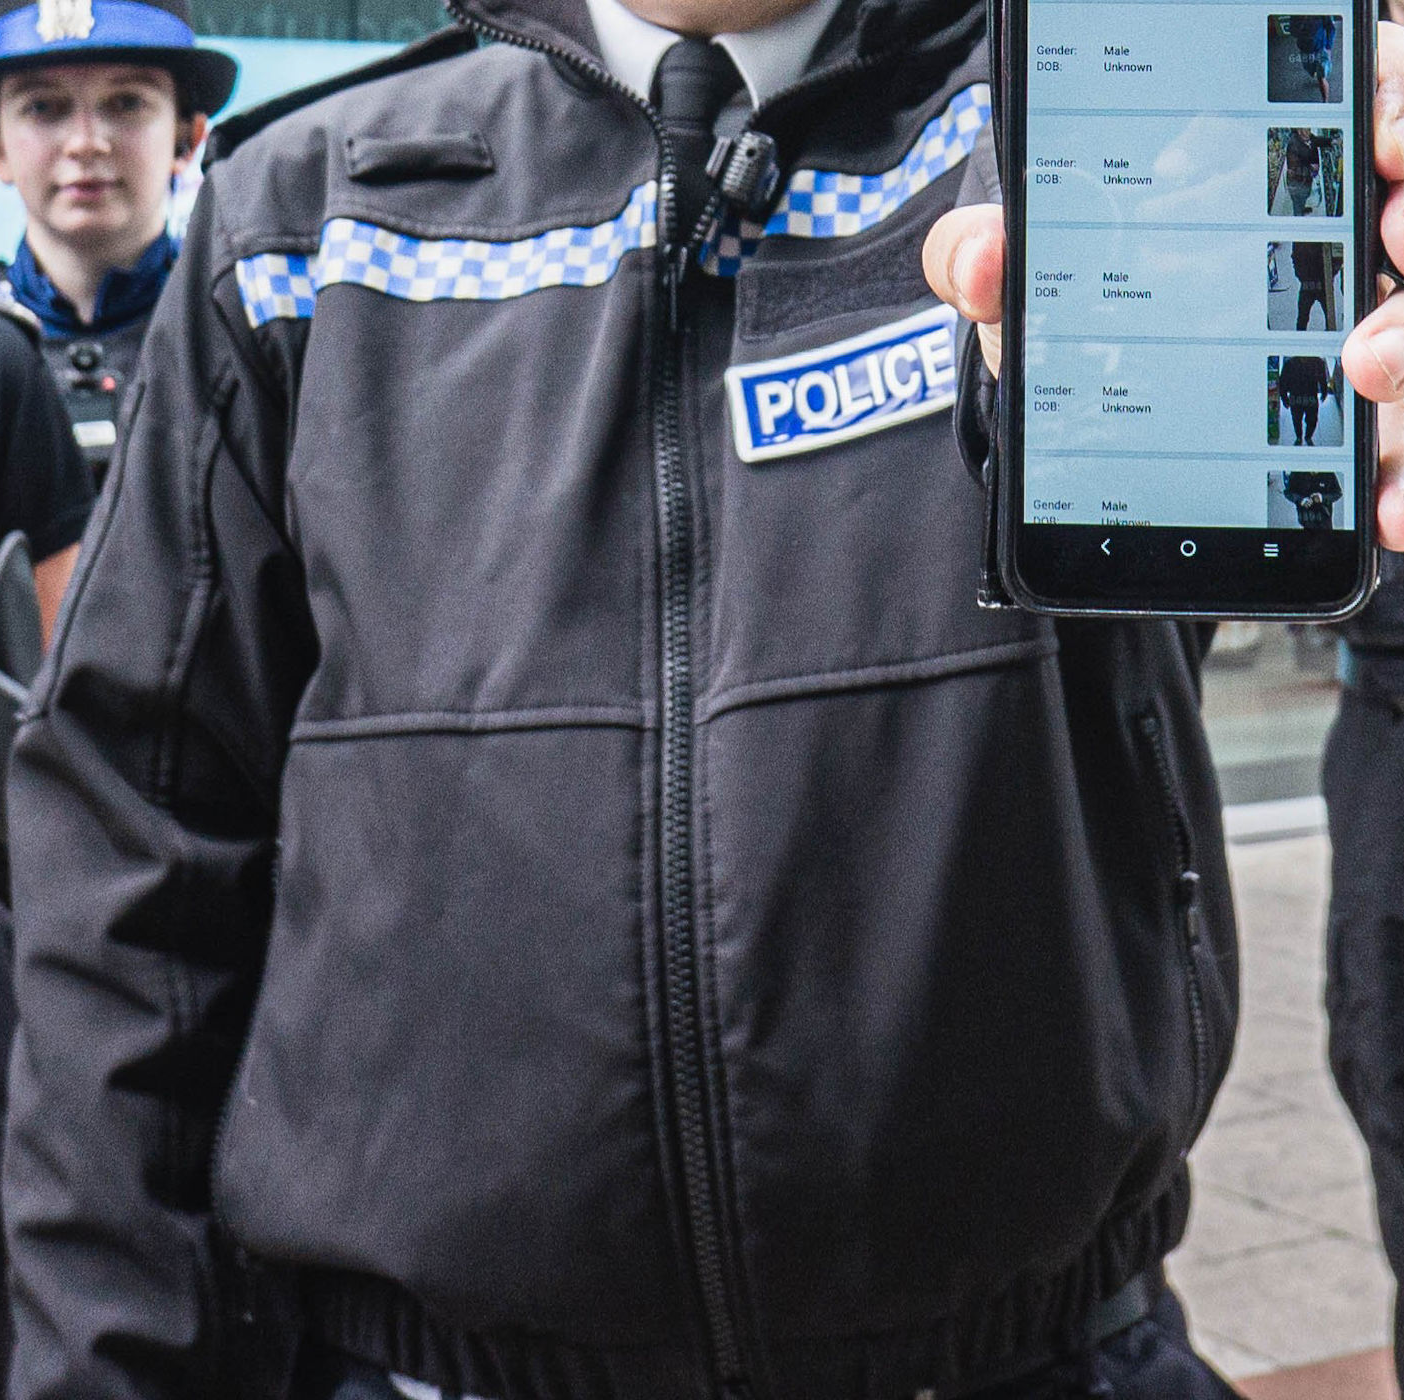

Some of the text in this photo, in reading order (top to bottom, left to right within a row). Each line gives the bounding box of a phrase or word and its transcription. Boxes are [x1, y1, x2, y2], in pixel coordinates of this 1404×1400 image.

[1036, 46, 1129, 56] Gender: Male
[1036, 62, 1152, 72] DOB: Unknown
[1035, 158, 1129, 169] Gender: Male
[1035, 174, 1152, 185] DOB: Unknown
[1034, 271, 1128, 282] Gender: Male
[1034, 287, 1151, 298] DOB: Unknown
[755, 327, 955, 435] POLICE
[1033, 385, 1127, 396] Gender: Male
[1033, 402, 1150, 413] DOB: Unknown
[1033, 500, 1128, 512] Gender: Male
